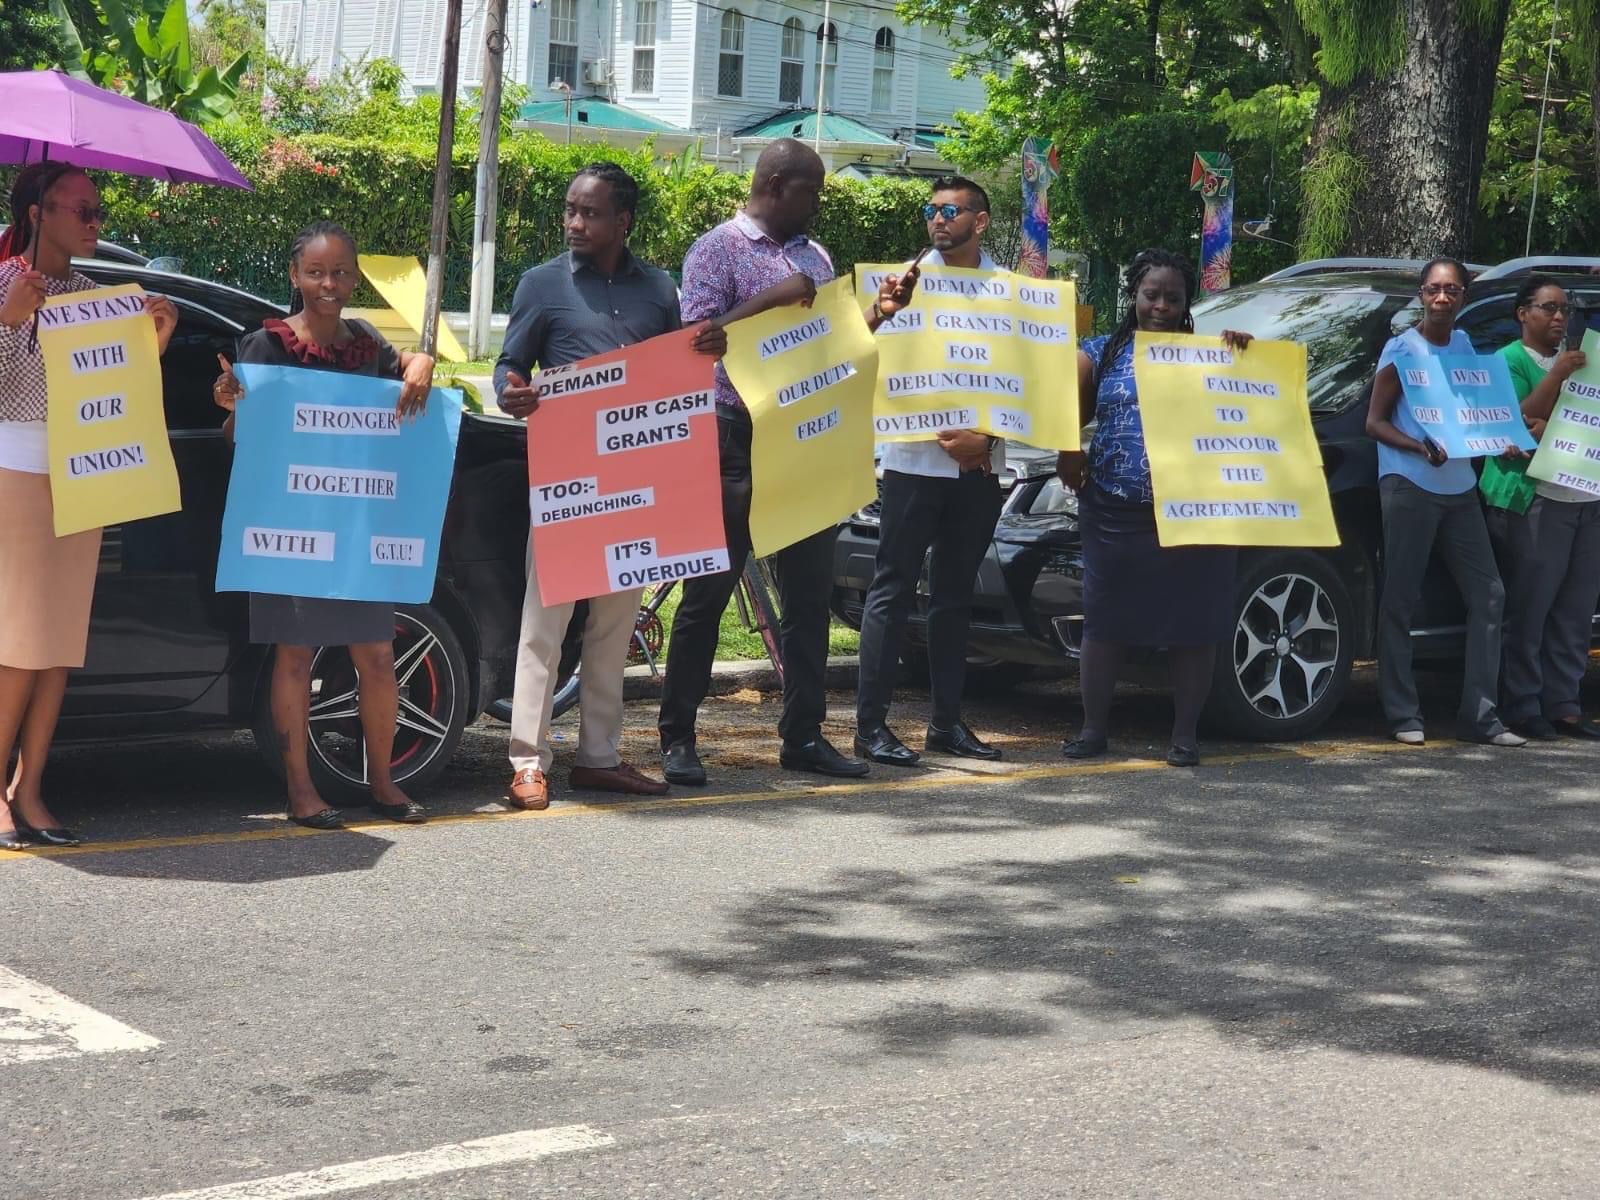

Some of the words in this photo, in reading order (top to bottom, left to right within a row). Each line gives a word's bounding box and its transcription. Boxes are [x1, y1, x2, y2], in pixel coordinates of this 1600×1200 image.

[923, 278, 1005, 296] DEMAND
[1019, 288, 1056, 305] OUR
[39, 305, 76, 327] WE
[78, 295, 145, 322] STAND
[881, 312, 922, 329] ASH
[935, 314, 1012, 331] GRANTS
[1018, 320, 1067, 339] TOO:-
[761, 317, 828, 357] APPROVE
[73, 345, 125, 371] WITH
[949, 345, 988, 361] FOR
[1150, 346, 1187, 363] YOU
[1192, 350, 1232, 364] ARE
[538, 367, 624, 397] DEMAND
[543, 366, 572, 377] WE
[1408, 370, 1427, 385] WE
[1453, 369, 1488, 384] WNT
[778, 380, 811, 405] OUR
[814, 360, 852, 391] DUTY
[888, 372, 1020, 393] DEBUNCHING
[1207, 377, 1276, 396] FAILING
[80, 398, 122, 421] OUR
[606, 404, 648, 425] OUR
[654, 392, 709, 416] CASH
[1217, 408, 1244, 423] TO
[1414, 408, 1440, 422] OUR
[1461, 408, 1511, 422] MONIES
[1563, 408, 1600, 427] TEAC
[296, 409, 397, 430] STRONGER
[797, 410, 838, 440] FREE!
[876, 410, 970, 432] OVERDUE
[1000, 413, 1024, 431] 2%
[606, 423, 689, 451] GRANTS
[1196, 438, 1278, 452] HONOUR
[1554, 439, 1577, 453] WE
[70, 446, 144, 475] UNION!
[289, 472, 395, 497] TOGETHER
[1222, 468, 1263, 482] THE
[539, 481, 596, 501] TOO:-
[541, 494, 647, 523] DEBUNCHING,
[1166, 503, 1297, 518] AGREEMENT!
[253, 533, 316, 553] WITH
[375, 543, 413, 561] G.T.U!
[614, 541, 652, 561] IT'S
[618, 556, 721, 588] OVERDUE.
